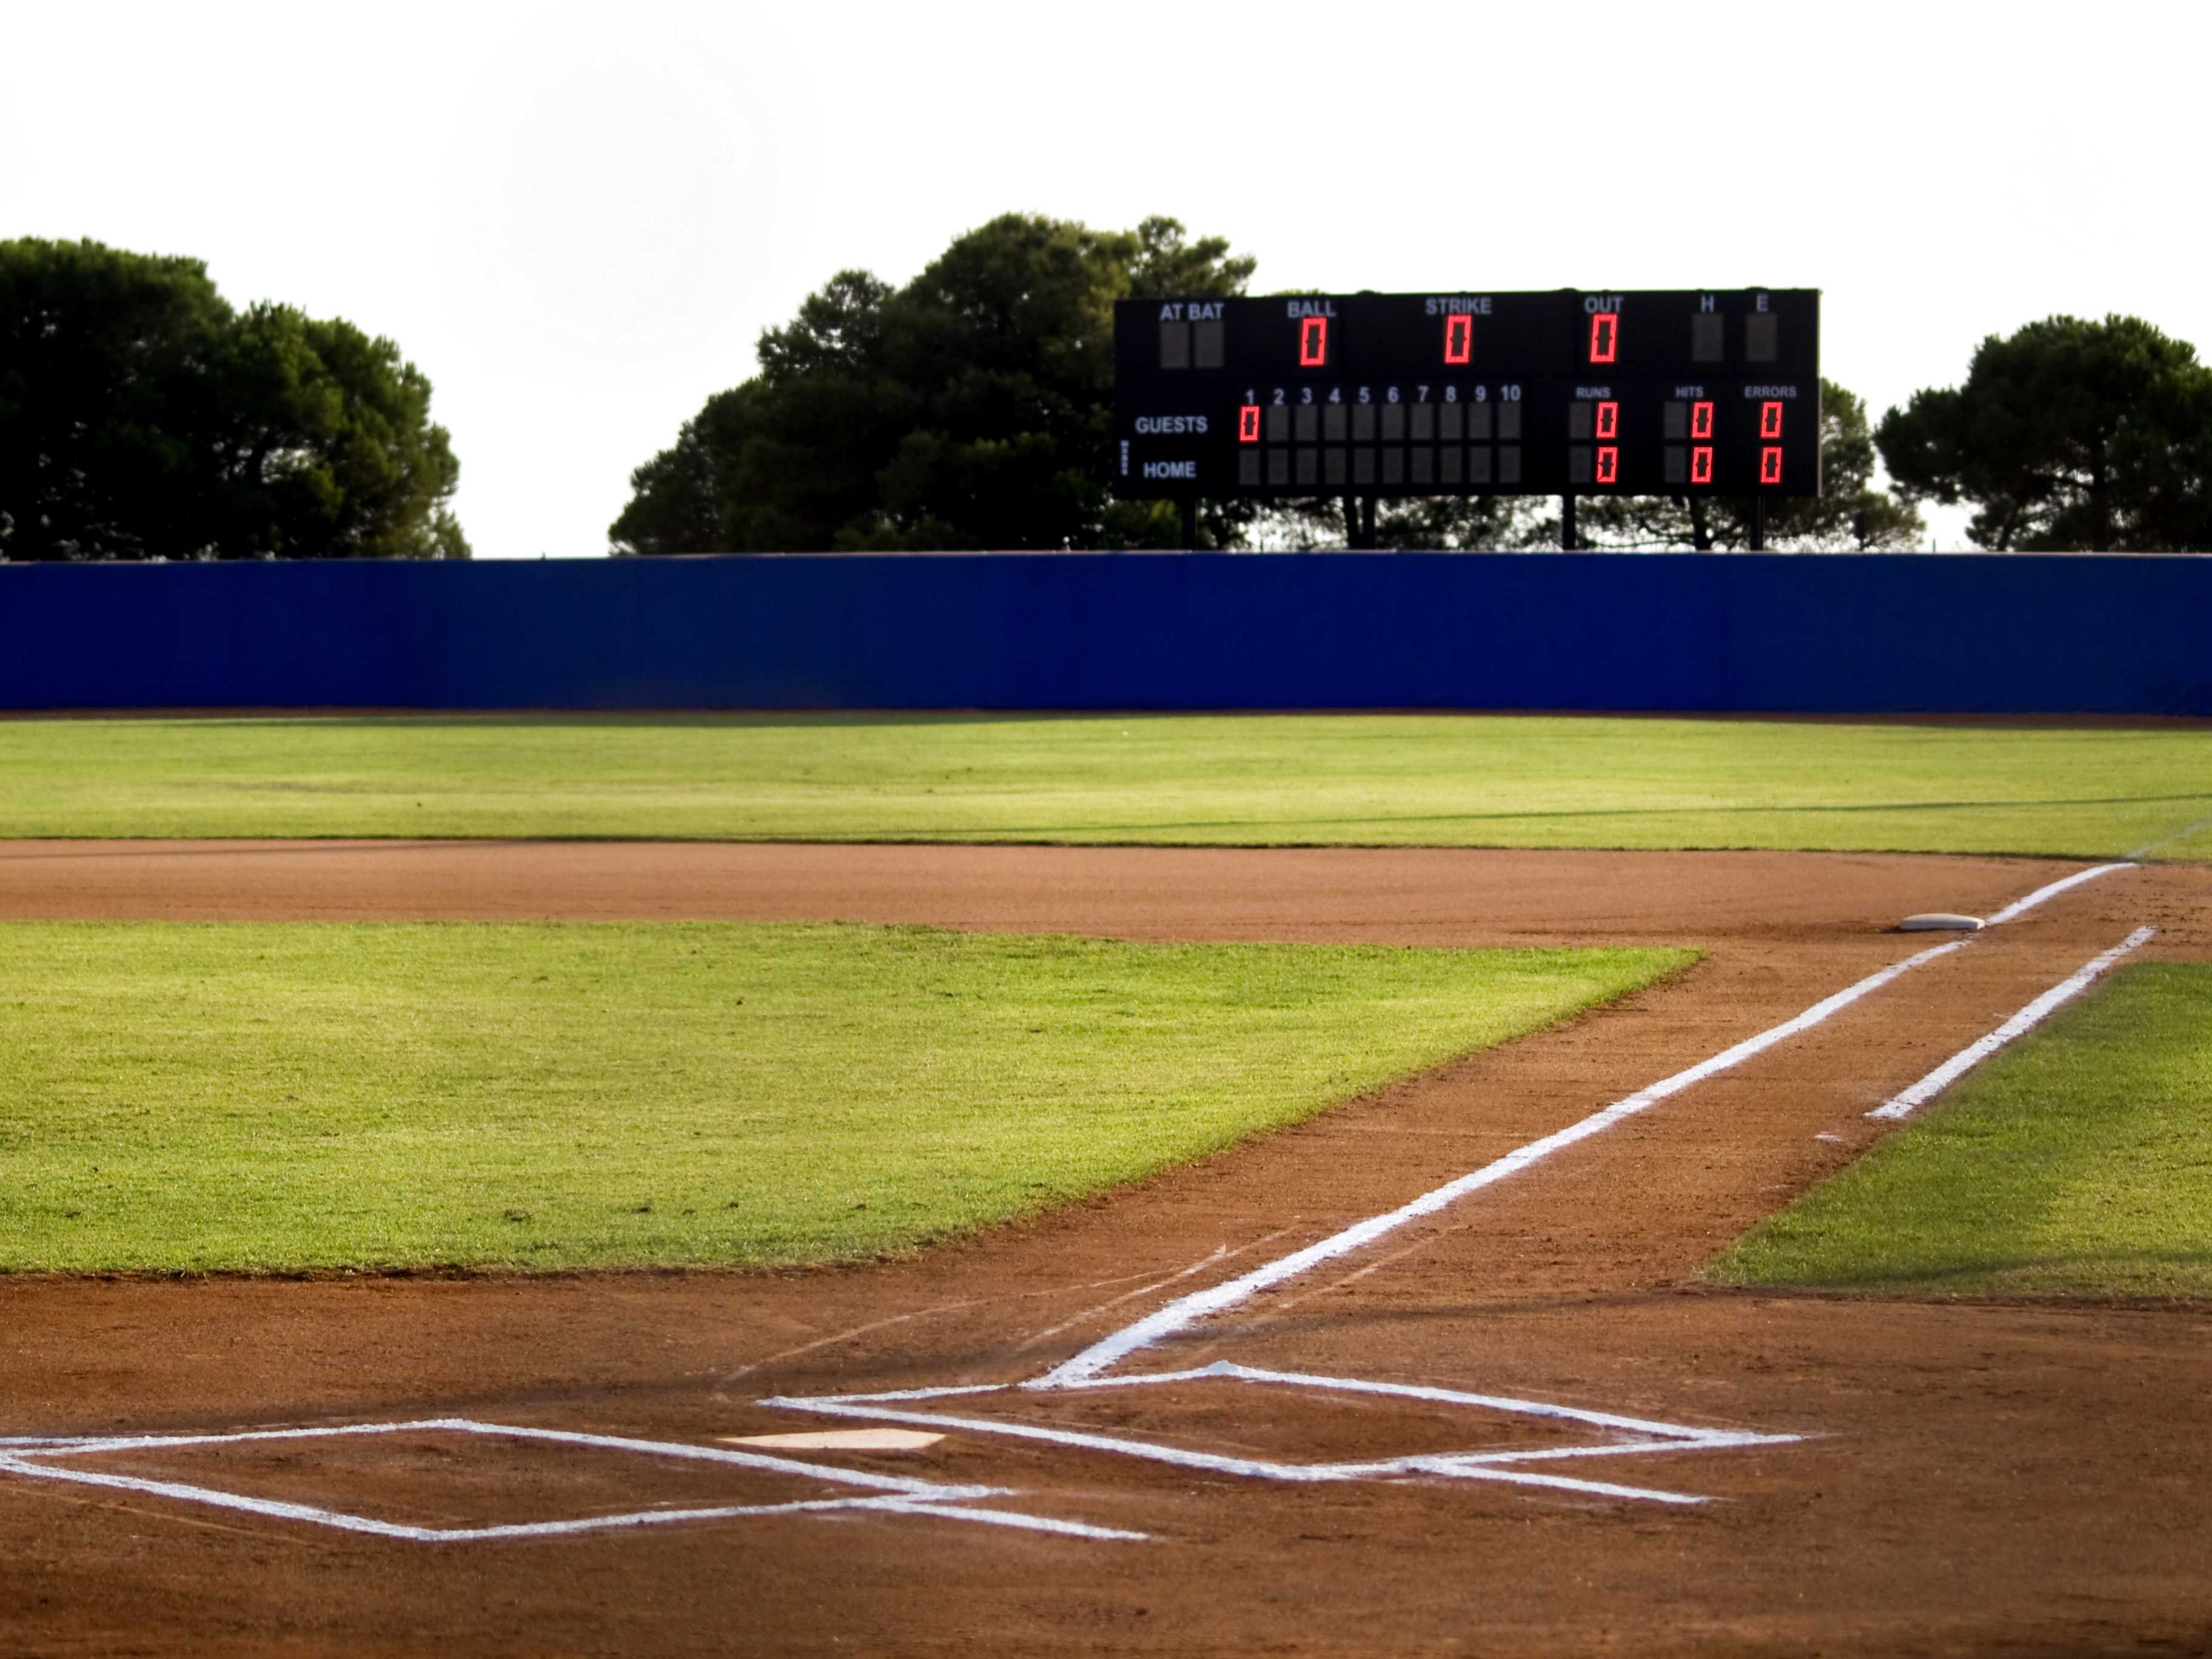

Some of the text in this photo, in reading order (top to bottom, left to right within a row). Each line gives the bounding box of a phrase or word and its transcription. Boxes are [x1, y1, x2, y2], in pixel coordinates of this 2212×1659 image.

[1160, 302, 1224, 321] AT BAT
[1287, 300, 1336, 318] BALL
[1426, 297, 1492, 315] STRIKE
[1584, 296, 1624, 313] OUT
[1701, 295, 1714, 312] H
[1757, 294, 1768, 312] E
[1300, 317, 1327, 366] 0
[1445, 315, 1472, 364] 0
[1590, 313, 1618, 363] 0
[1246, 384, 1521, 405] 1 2 3 4 5 6 7 8 9 10
[1577, 387, 1610, 398] RUNS
[1676, 386, 1704, 398] HITS
[1745, 386, 1797, 398] ERRORS
[1135, 416, 1208, 434] GUESTS
[1239, 406, 1259, 442] 0
[1597, 401, 1618, 439] 0
[1691, 401, 1714, 439] 0
[1760, 401, 1783, 438] 0
[1144, 461, 1196, 478] HOME
[1597, 447, 1618, 483] 0
[1691, 447, 1714, 483] 0
[1760, 447, 1783, 483] 0
